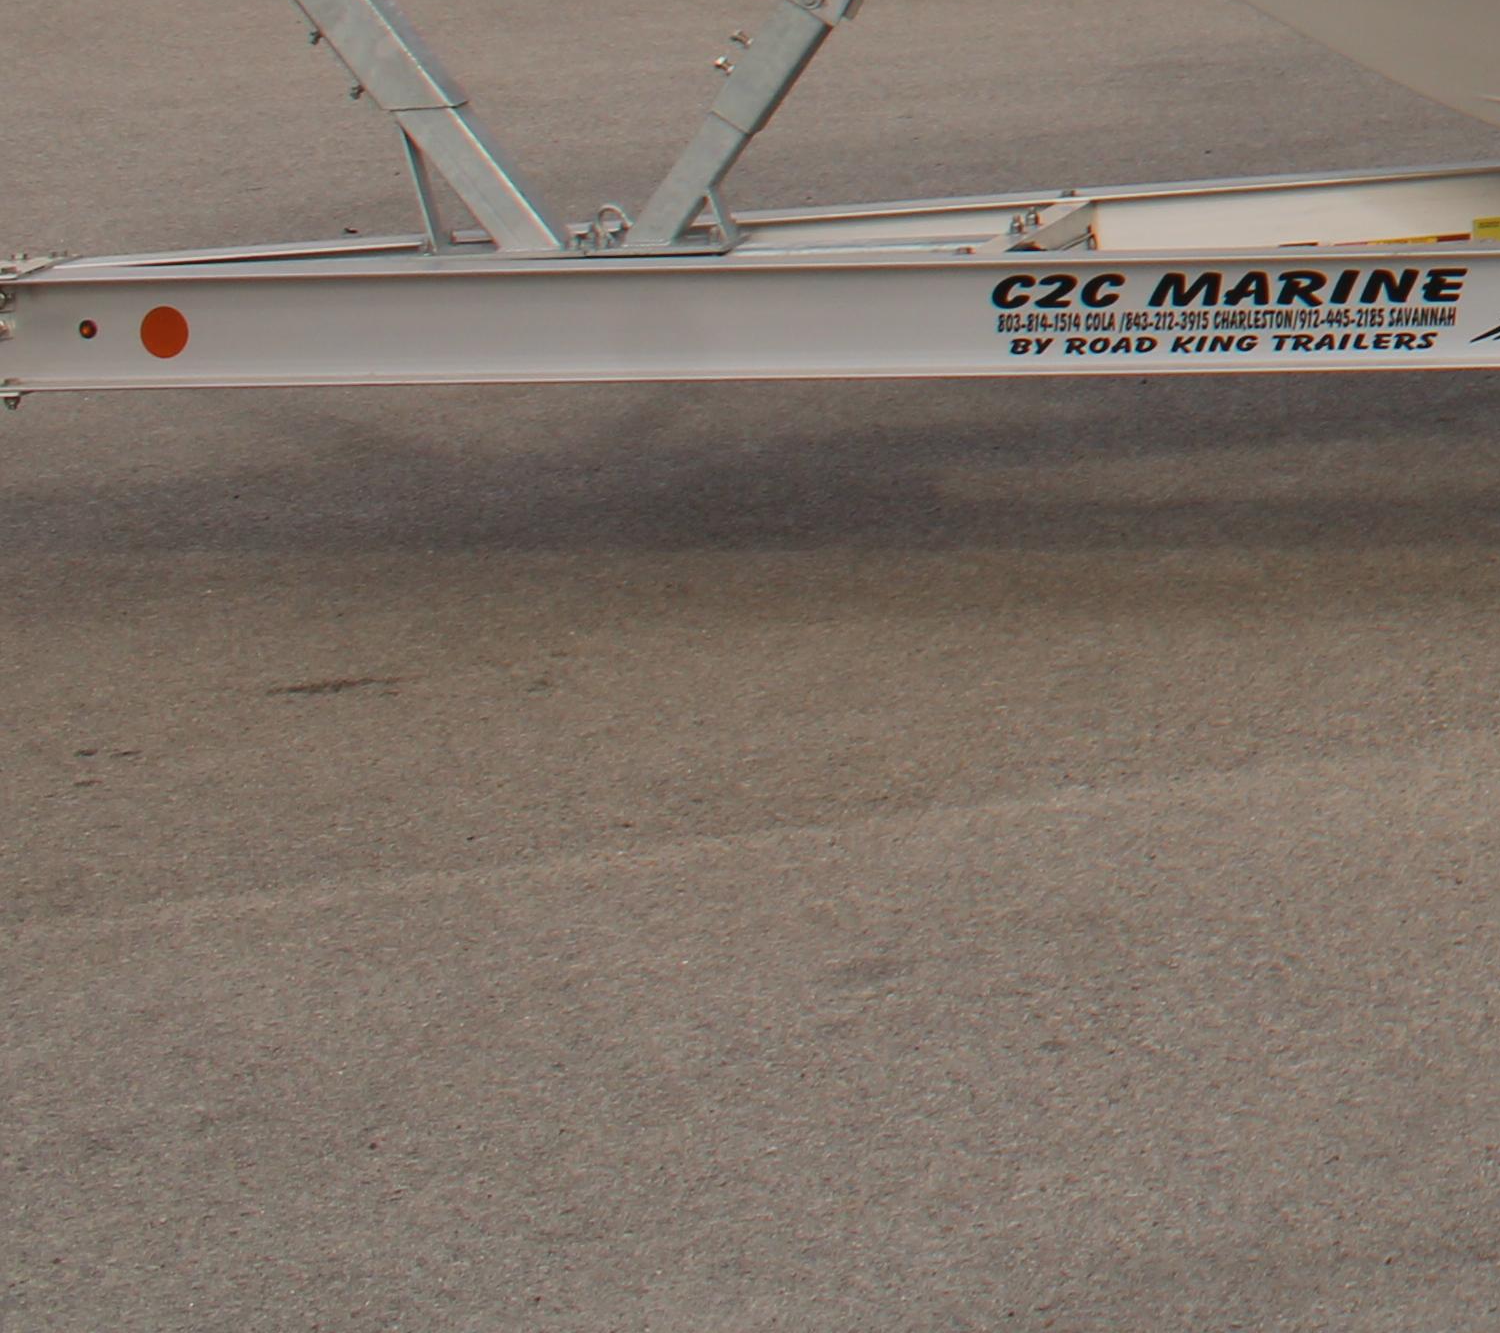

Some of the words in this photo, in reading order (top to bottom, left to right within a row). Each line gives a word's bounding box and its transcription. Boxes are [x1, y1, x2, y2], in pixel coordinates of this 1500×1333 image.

[991, 273, 1126, 309] C2C
[1147, 268, 1468, 307] MARINE
[998, 311, 1082, 333] 803-814-1514
[1085, 311, 1117, 332] COLA
[1388, 306, 1457, 328] SAVANNAH
[1009, 337, 1054, 355] BY
[1064, 336, 1159, 355] ROAD
[1170, 335, 1259, 354] KING
[1271, 332, 1439, 352] TRAILERS
